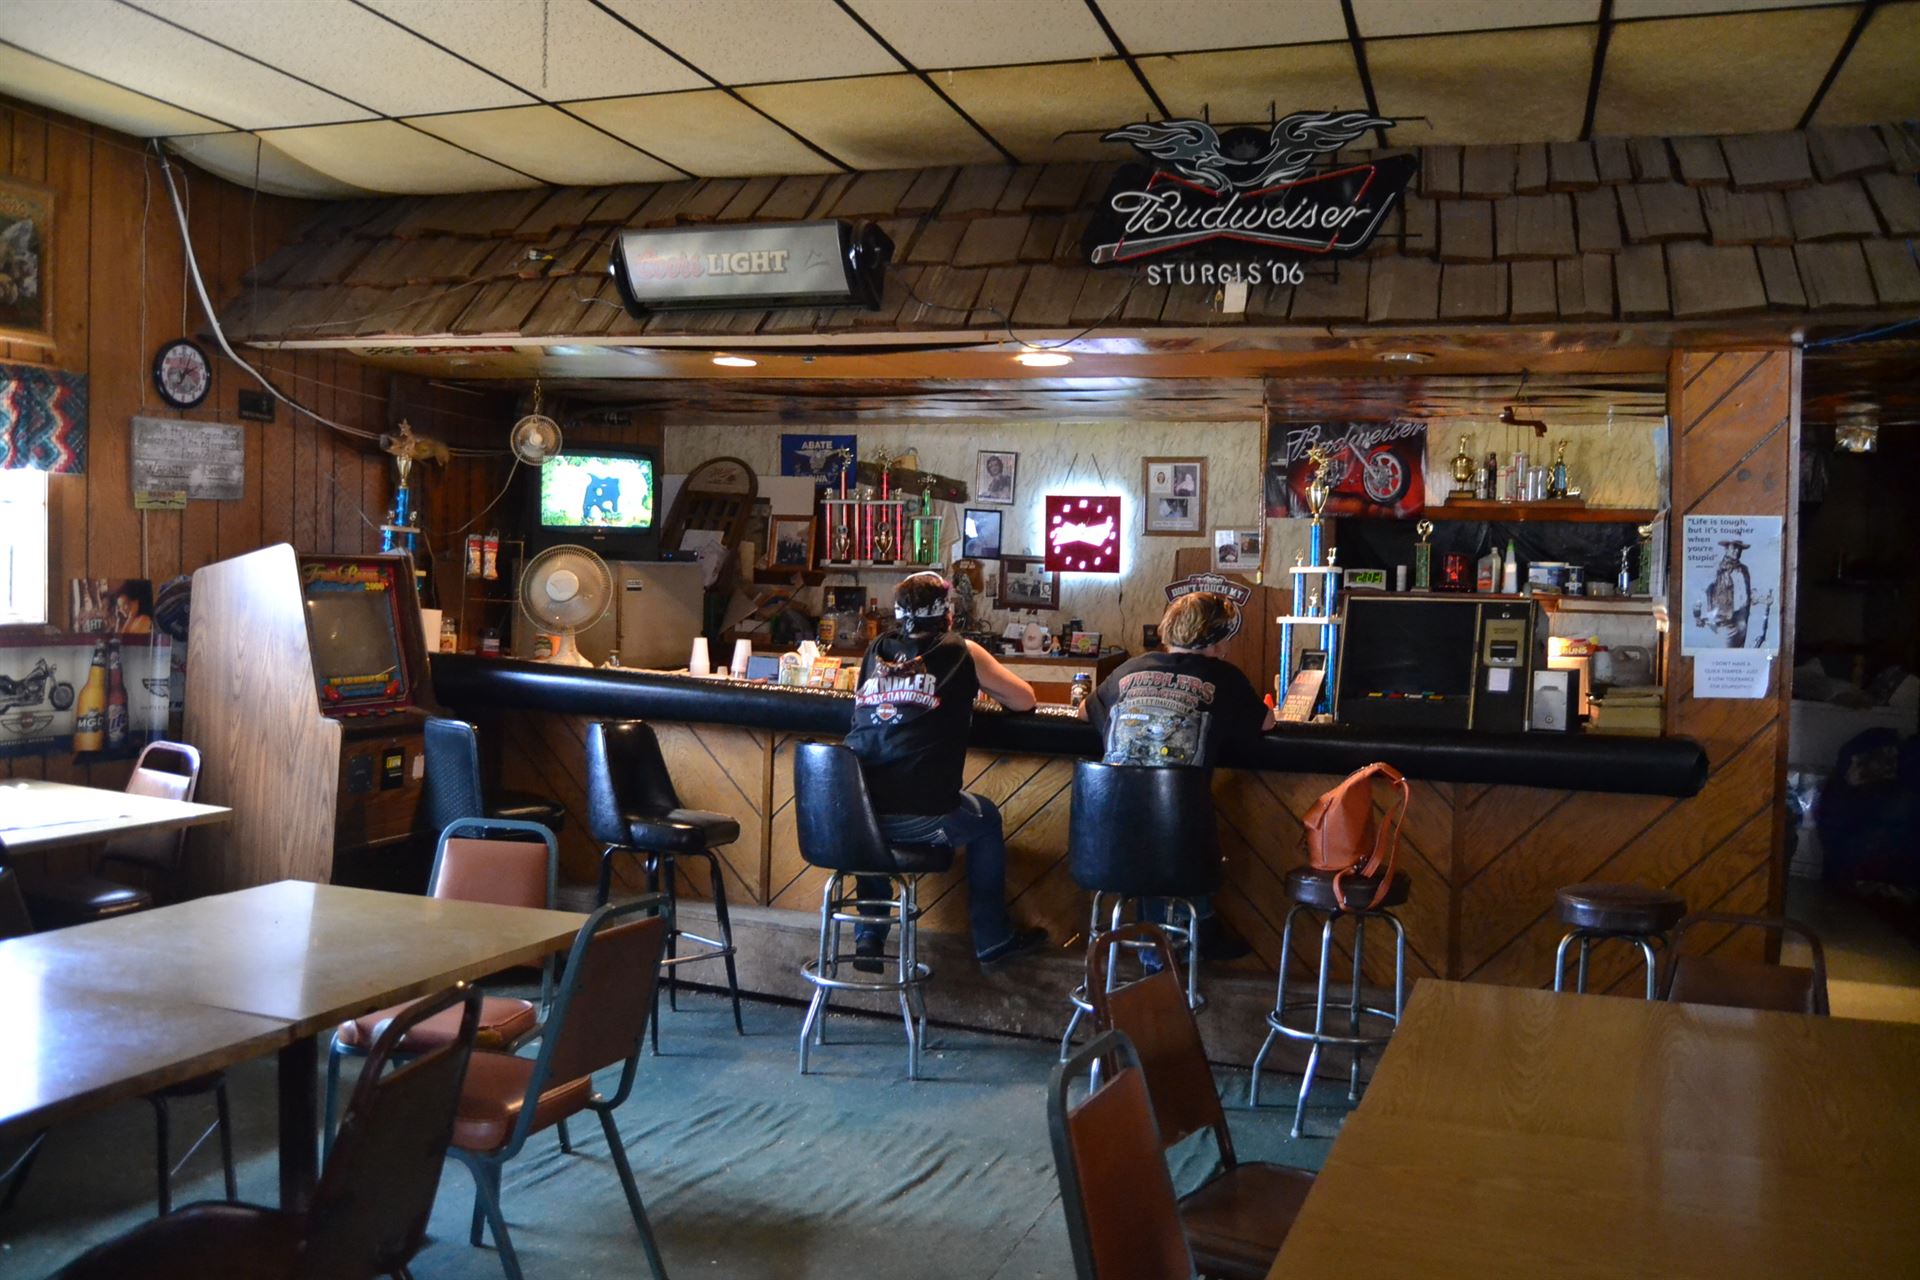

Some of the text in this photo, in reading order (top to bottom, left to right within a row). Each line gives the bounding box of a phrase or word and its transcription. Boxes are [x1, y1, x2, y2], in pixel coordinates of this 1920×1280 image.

[1111, 191, 1372, 233] Budweiser
[706, 250, 789, 276] LIGHT
[1147, 260, 1305, 286] STURGIS '06
[801, 440, 833, 449] ABATE
[1286, 422, 1426, 462] Budweiser
[1710, 518, 1718, 526] is
[1720, 527, 1754, 535] tougher
[1171, 583, 1245, 599] DON'T TOUCH MY
